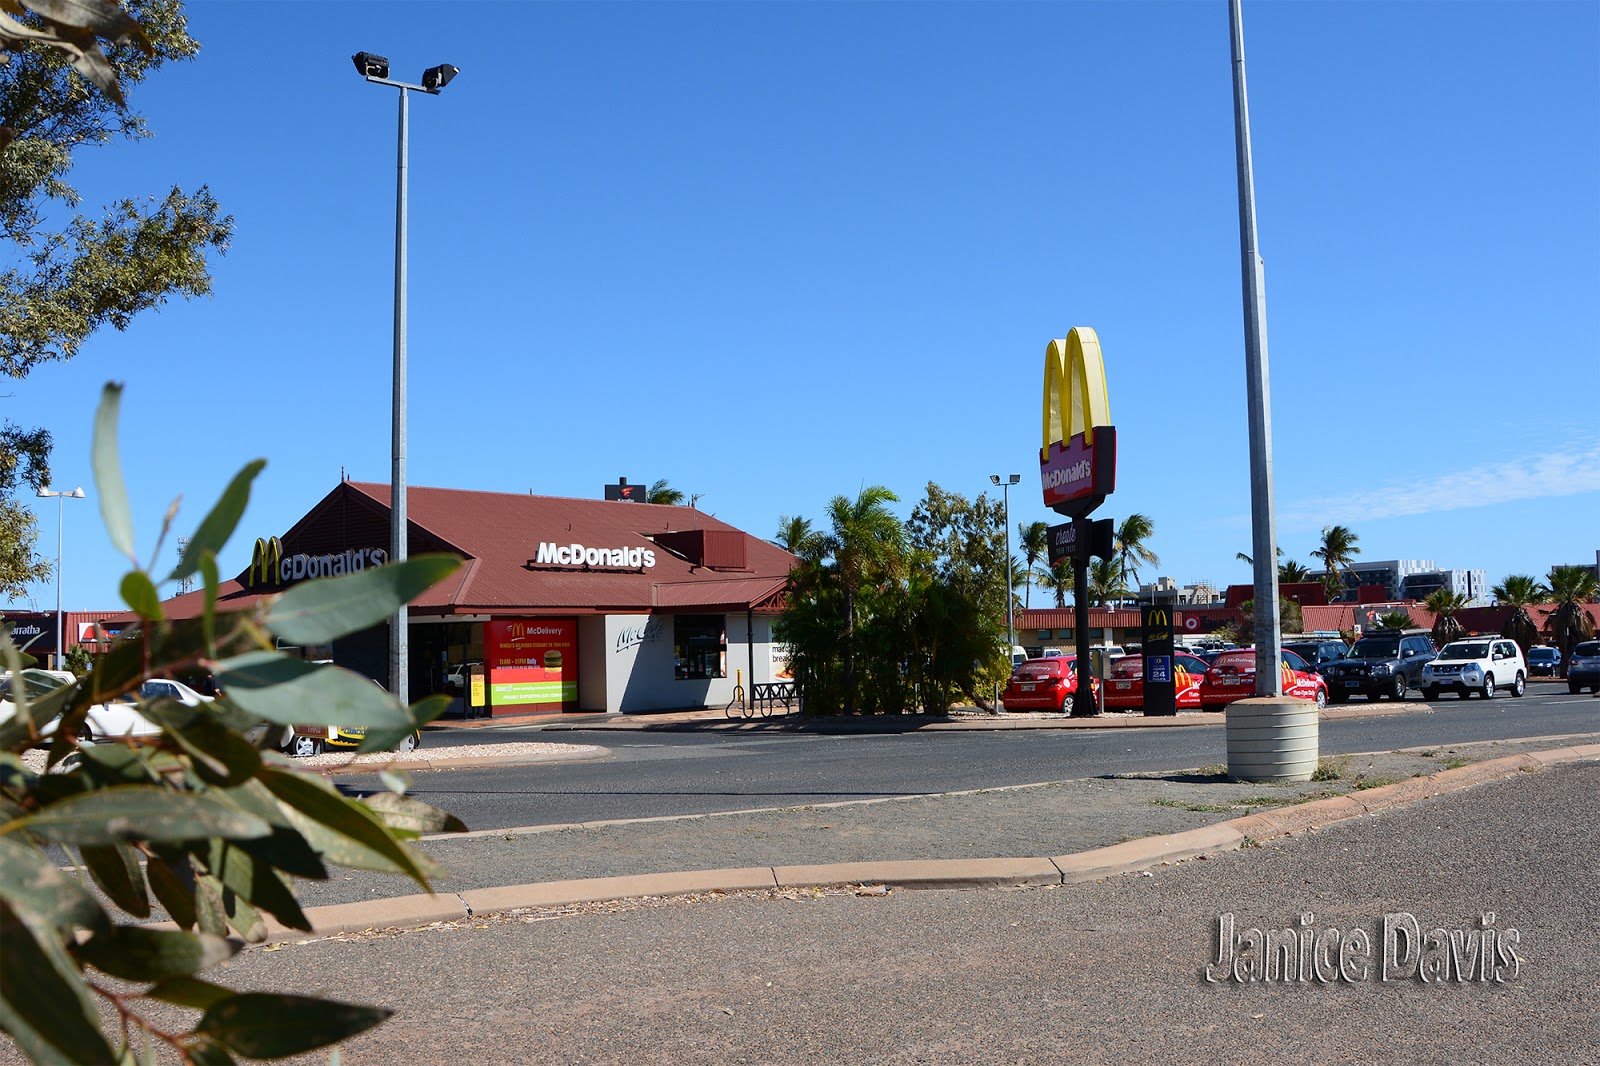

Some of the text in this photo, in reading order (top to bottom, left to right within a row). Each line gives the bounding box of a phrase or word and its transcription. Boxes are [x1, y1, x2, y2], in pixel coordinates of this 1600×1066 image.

[1042, 459, 1092, 490] McDonald's
[536, 542, 656, 568] McDonald's
[10, 625, 41, 635] arratha
[526, 626, 562, 636] McDelivery
[1296, 678, 1318, 688] McDelivery
